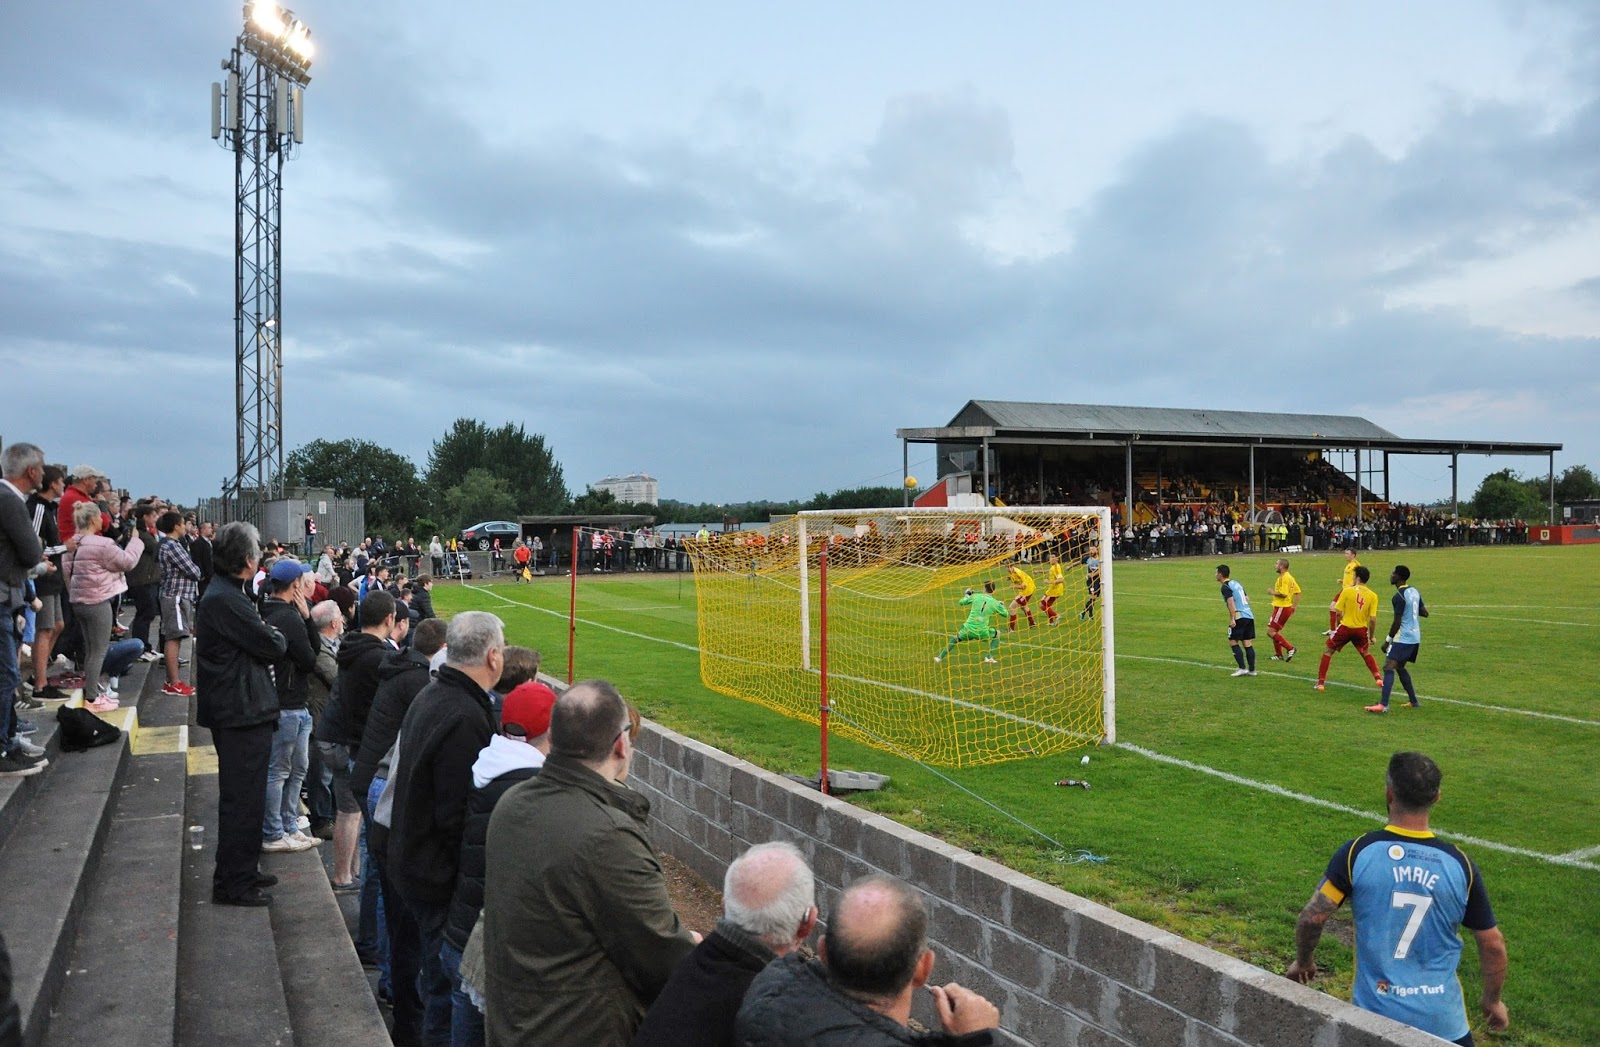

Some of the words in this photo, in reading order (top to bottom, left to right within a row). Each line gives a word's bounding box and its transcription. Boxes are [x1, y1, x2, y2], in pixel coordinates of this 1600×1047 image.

[1356, 592, 1365, 611] 4
[1392, 866, 1440, 890] IMRIE
[1392, 891, 1433, 959] 7
[1390, 985, 1419, 997] Tiger
[1420, 984, 1444, 995] Turf
